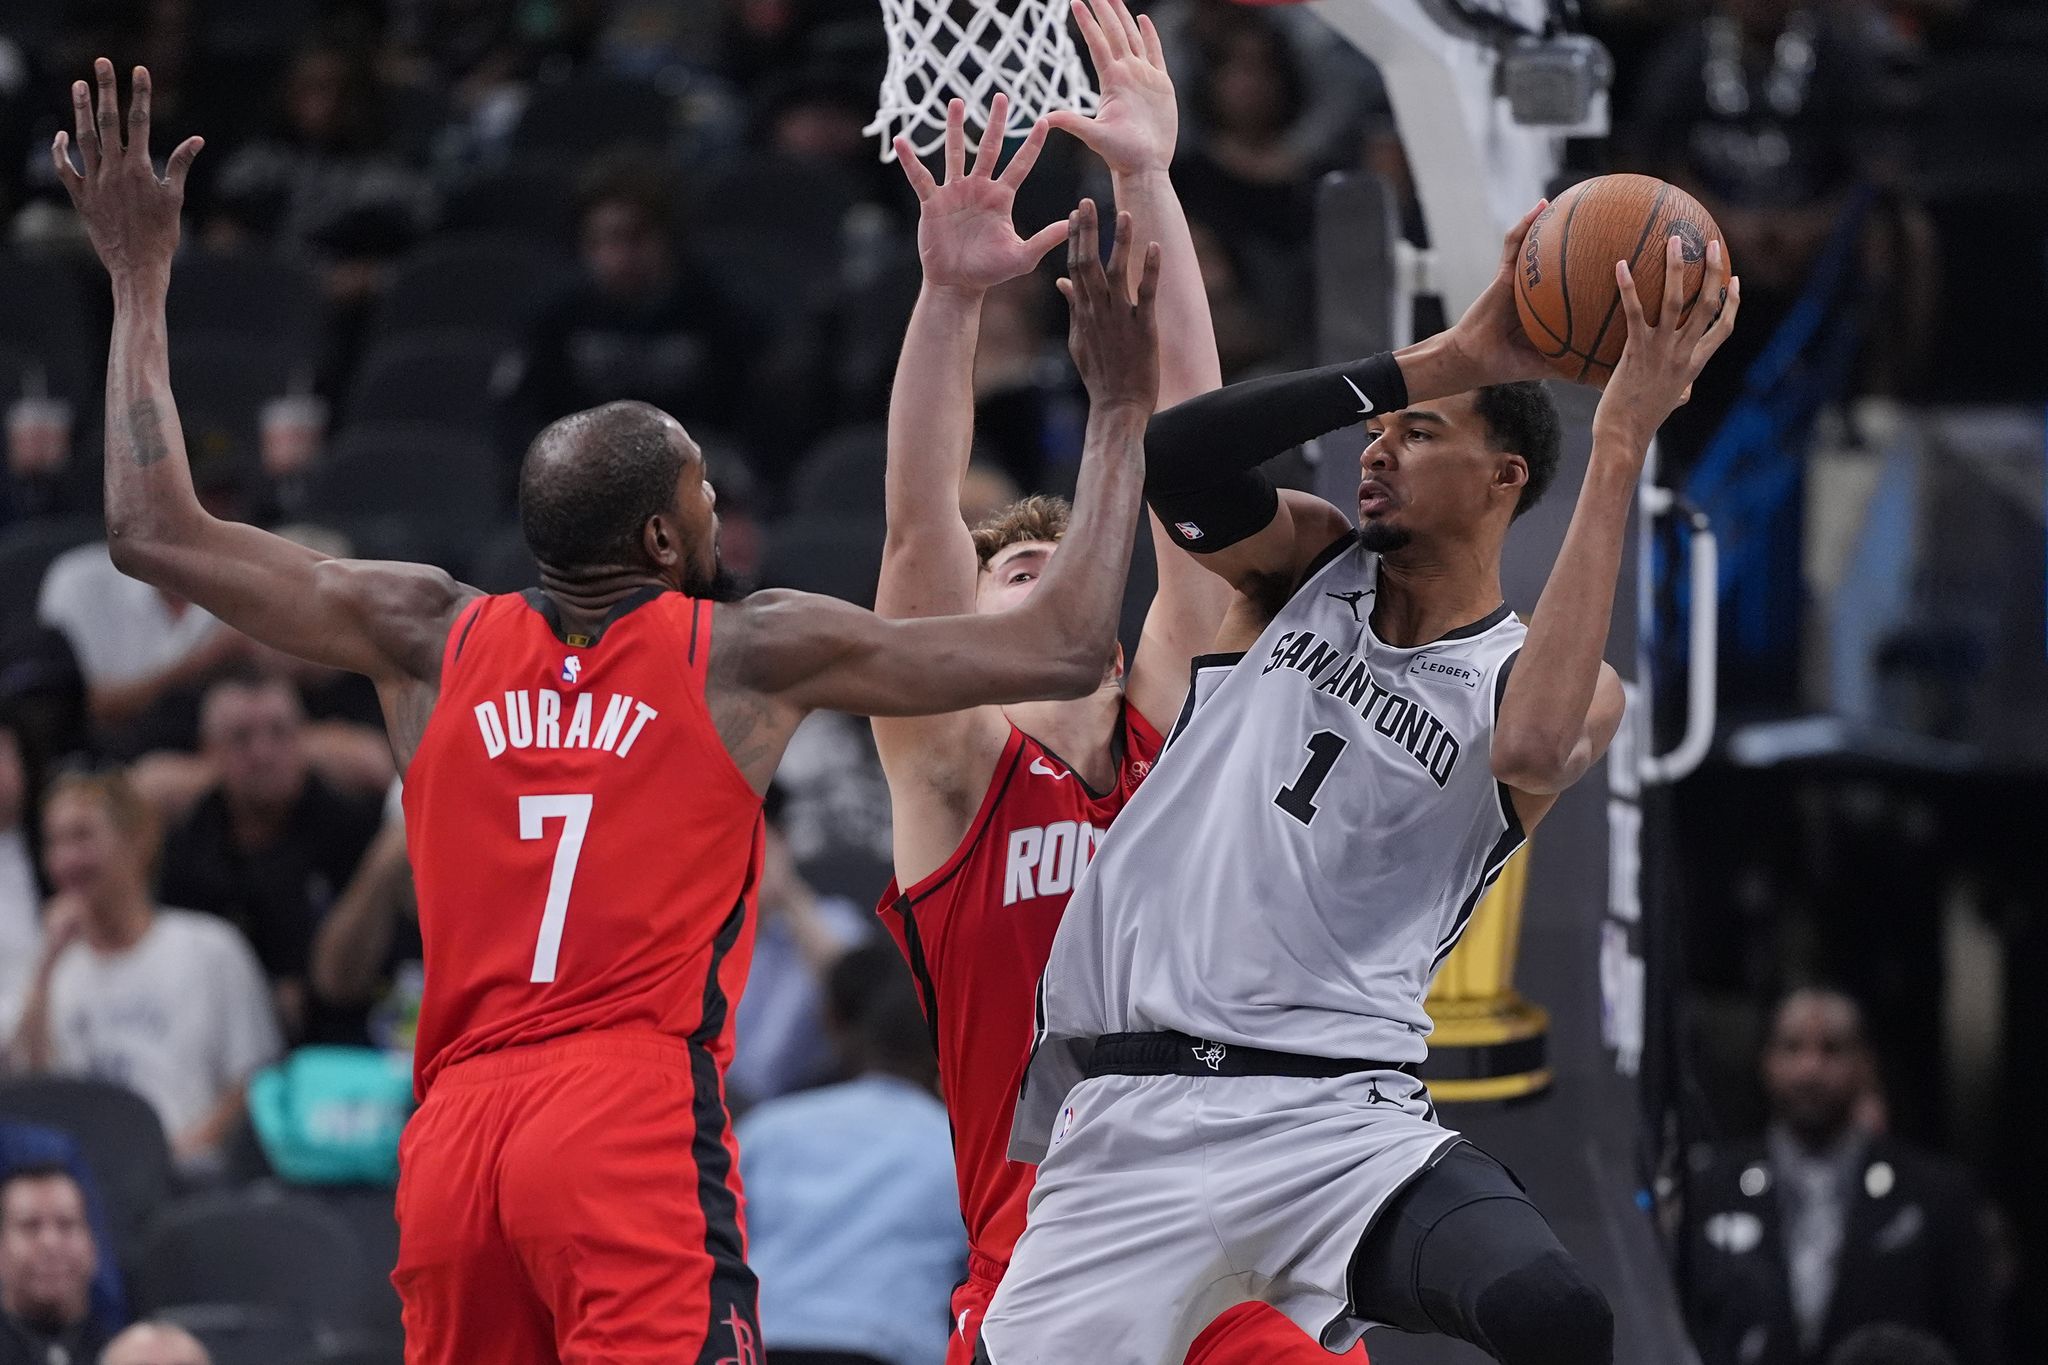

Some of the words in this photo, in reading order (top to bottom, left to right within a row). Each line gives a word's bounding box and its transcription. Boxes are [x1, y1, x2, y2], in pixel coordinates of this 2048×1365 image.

[1262, 631, 1341, 682] SAN
[1315, 655, 1461, 789] ANTONIO
[1421, 661, 1470, 680] LEDGER
[474, 688, 658, 759] DURANT
[1271, 728, 1350, 827] 1
[518, 794, 593, 983] 7
